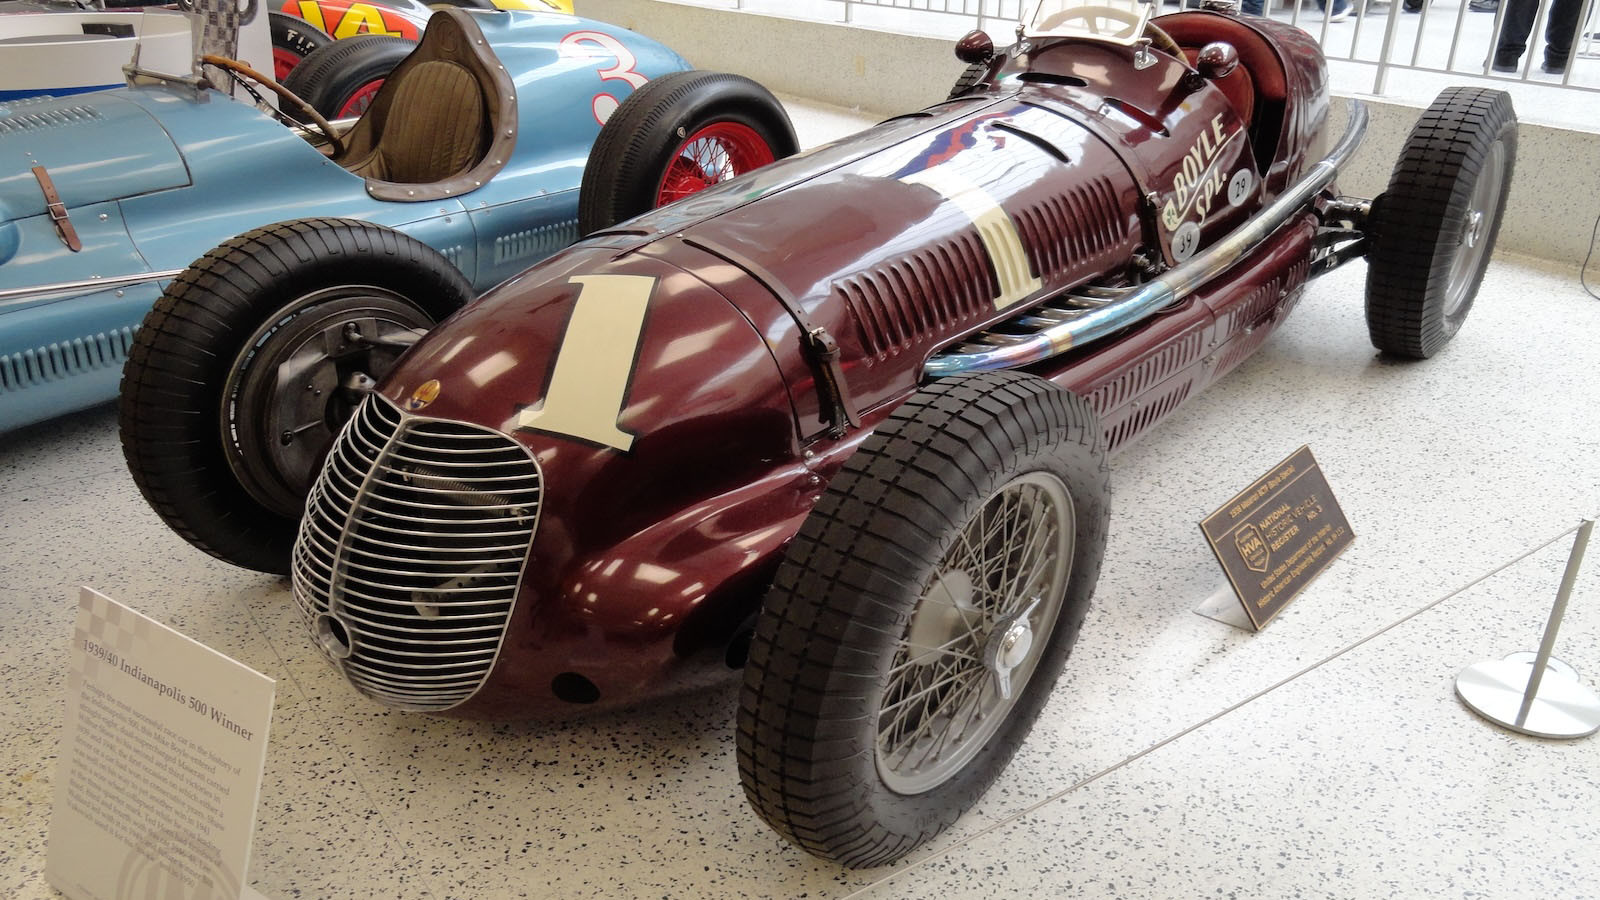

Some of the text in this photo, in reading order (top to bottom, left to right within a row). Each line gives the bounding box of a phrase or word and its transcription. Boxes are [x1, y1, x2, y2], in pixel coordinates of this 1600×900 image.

[558, 30, 649, 127] 3
[1173, 112, 1227, 212] BOYLE
[1196, 166, 1228, 226] SPL.
[1235, 177, 1246, 199] 29
[1180, 231, 1192, 253] 39
[516, 273, 657, 453] 1
[1259, 503, 1290, 530] NATIONAL
[1241, 537, 1262, 557] HVA
[1271, 525, 1299, 552] REGISTER
[83, 640, 118, 668] 1939/40
[120, 659, 186, 706] Indianapolis
[188, 697, 207, 716] 500
[211, 707, 254, 740] Winner
